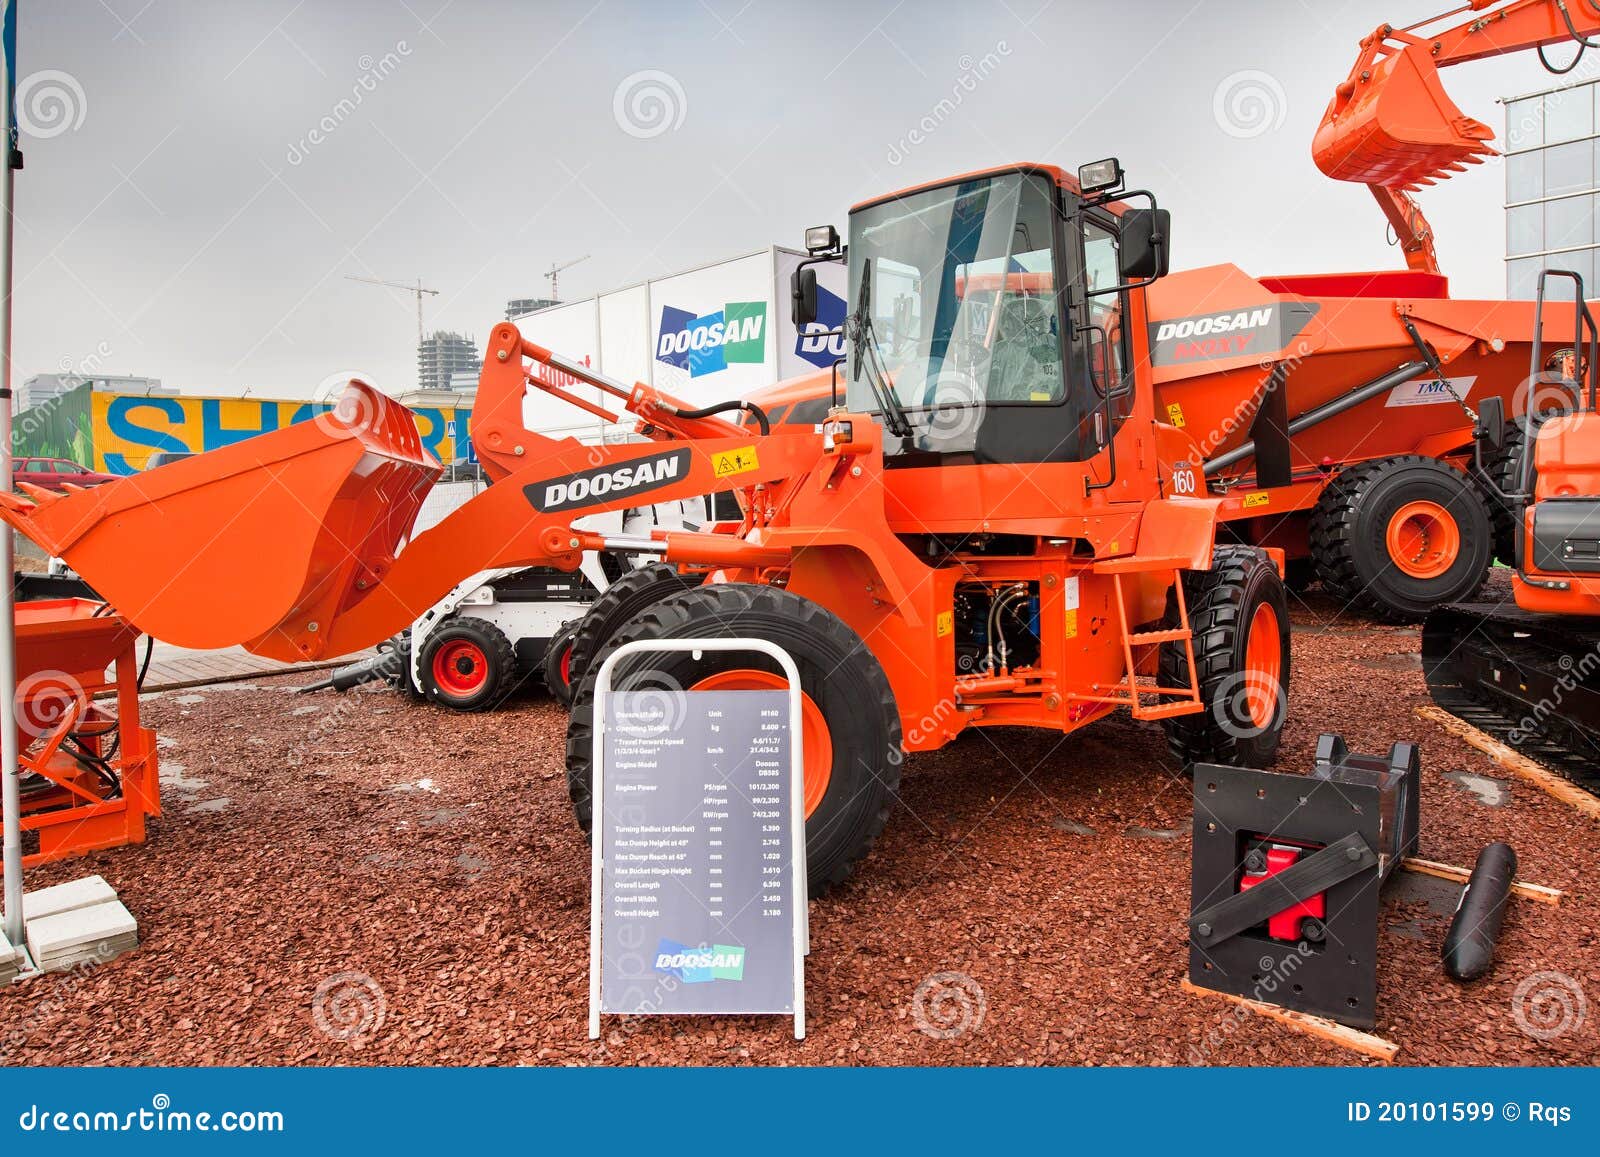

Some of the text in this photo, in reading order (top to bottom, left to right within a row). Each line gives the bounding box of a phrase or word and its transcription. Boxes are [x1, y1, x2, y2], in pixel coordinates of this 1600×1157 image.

[1156, 308, 1272, 341] DOOSAN
[659, 315, 763, 357] DOOSAN
[1174, 333, 1255, 360] MOXY
[1418, 382, 1452, 394] TMC
[545, 456, 679, 508] DOOSAN
[1172, 470, 1195, 493] 160
[708, 710, 722, 718] Unit
[761, 709, 779, 718] M160
[712, 724, 719, 733] kg
[664, 738, 684, 747] Speed
[707, 746, 724, 754] km/h
[616, 760, 657, 770] Engine Model
[616, 784, 636, 793] Engine
[616, 825, 640, 834] Turning
[641, 825, 661, 833] Radius
[672, 825, 695, 833] Bucket)
[615, 839, 628, 847] Max
[629, 839, 648, 848] Dump
[649, 839, 670, 848] Height
[615, 853, 628, 861] Max
[629, 853, 648, 862] Dump
[649, 853, 668, 861] Reach
[615, 867, 692, 876] Max Bucket Hinge Height
[615, 881, 660, 890] Overall Length
[615, 895, 657, 903] Overall Width
[615, 909, 660, 918] Overall Height
[656, 953, 741, 968] DOOSAN
